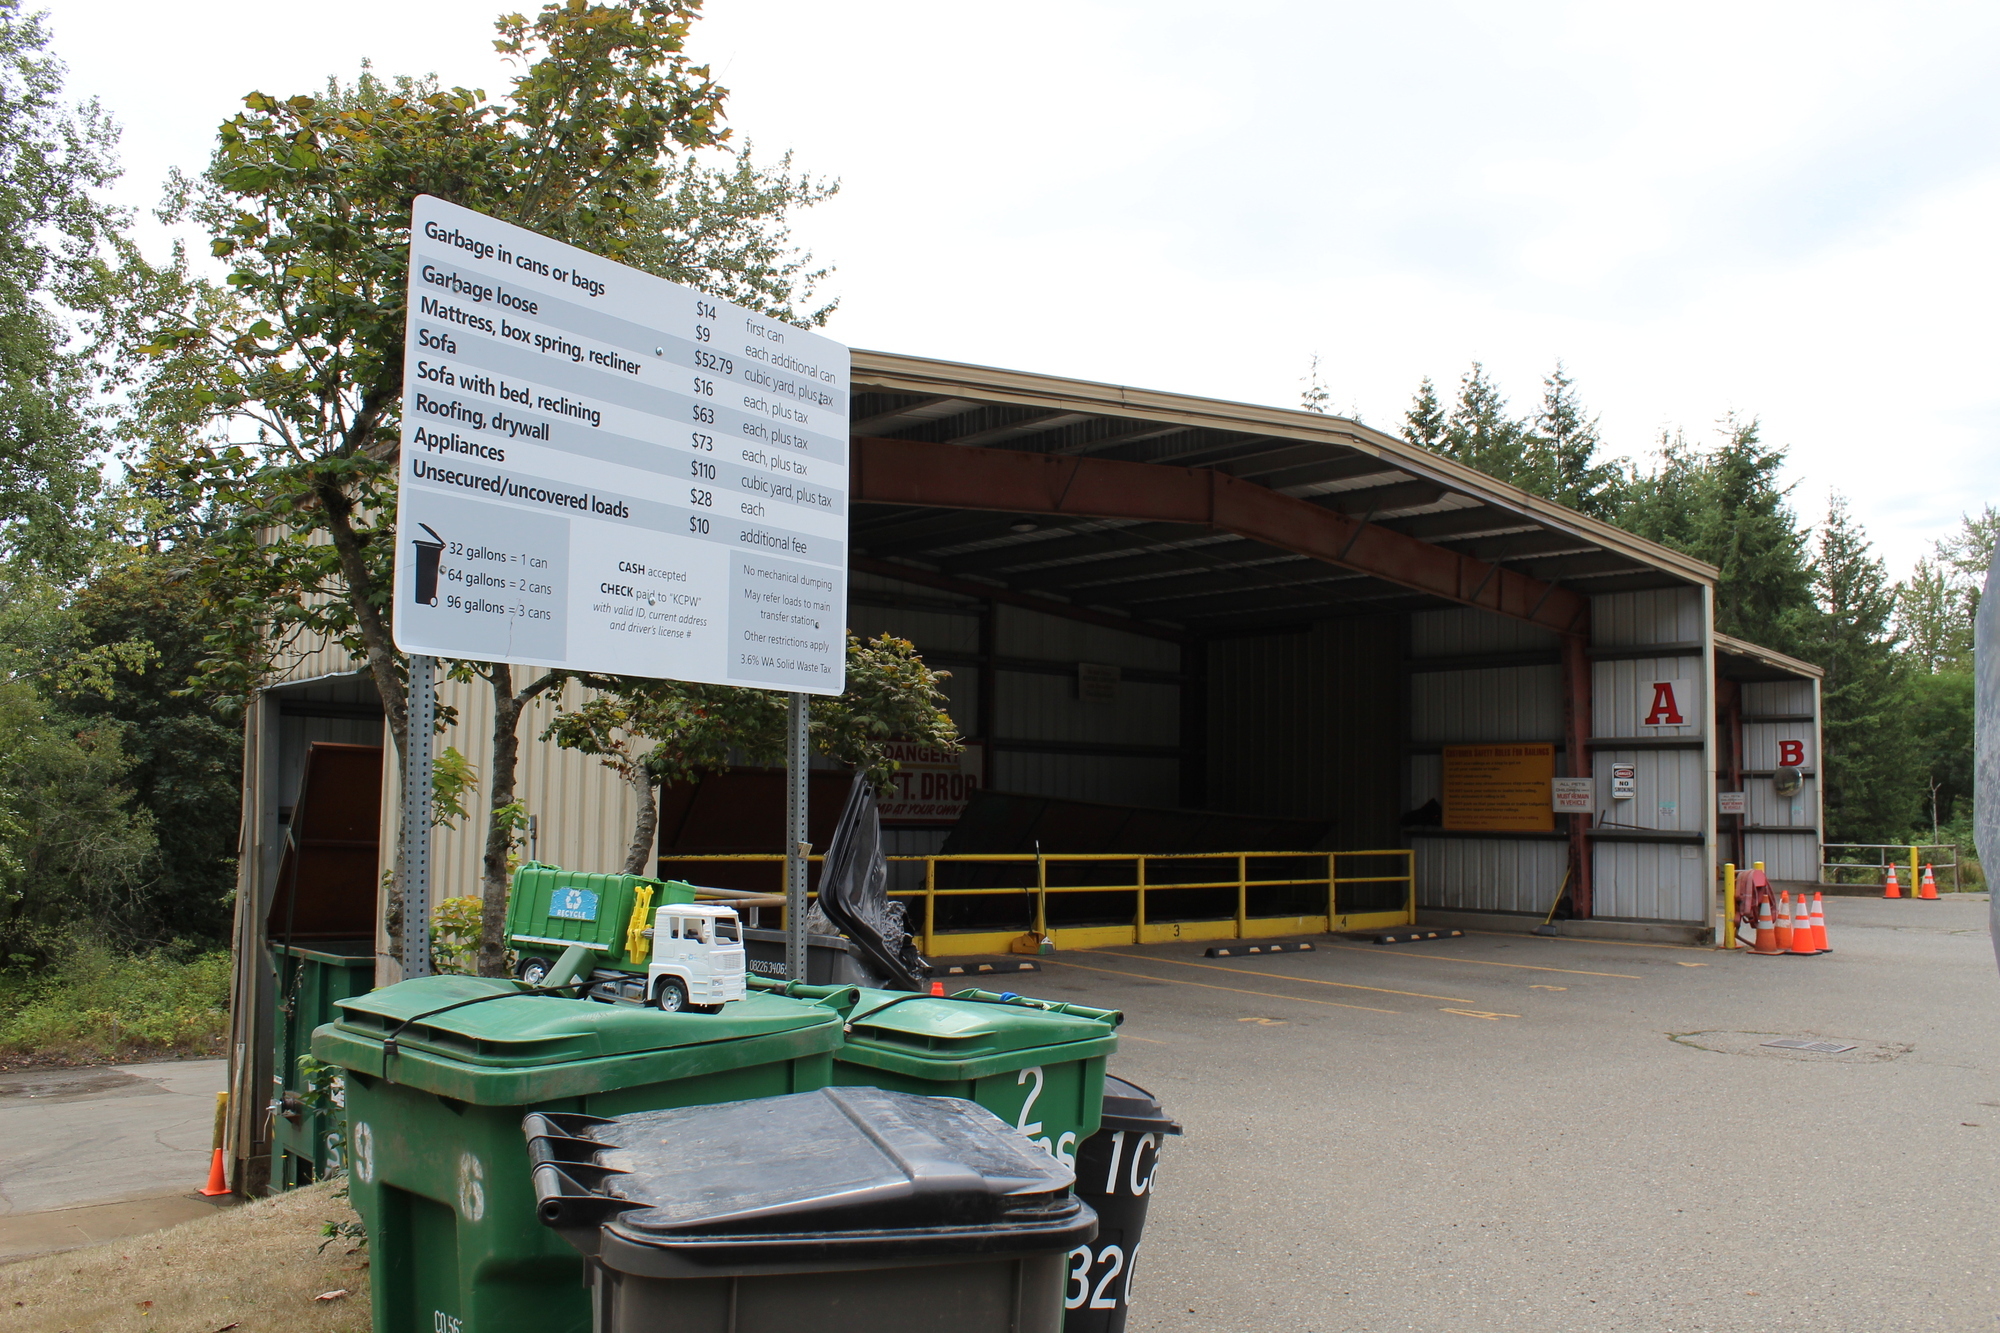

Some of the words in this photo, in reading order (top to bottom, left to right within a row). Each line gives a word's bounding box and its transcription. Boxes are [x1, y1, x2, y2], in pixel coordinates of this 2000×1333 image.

[424, 221, 494, 259] Garbage
[497, 243, 512, 264] in
[515, 255, 549, 276] cans
[552, 268, 569, 282] or
[571, 268, 605, 297] bags
[422, 264, 492, 302] Garbage
[496, 286, 538, 315] loose
[696, 300, 716, 321] $14
[418, 328, 456, 354] Sofa
[421, 295, 496, 336] Mattress,
[501, 318, 531, 344] box
[534, 334, 584, 362] spring,
[589, 350, 641, 375] recliner
[695, 323, 710, 343] $9
[746, 318, 765, 338] first
[766, 329, 784, 344] can
[694, 349, 733, 375] $52.79
[745, 345, 769, 362] each
[770, 353, 817, 378] additional
[819, 370, 835, 384] can
[417, 360, 454, 386] Sofa
[459, 374, 495, 396] with
[499, 380, 533, 409] bed,
[537, 396, 600, 427] reclining
[693, 376, 713, 397] $16
[744, 368, 771, 387] cubic
[772, 378, 796, 397] yard,
[798, 384, 817, 402] plus
[817, 391, 833, 407] tax
[416, 392, 487, 430] Roofing,
[491, 412, 549, 441] drywall
[692, 403, 714, 424] $63
[743, 396, 769, 415] each,
[771, 402, 792, 420] plus
[793, 409, 808, 424] tax
[413, 426, 505, 462] Appliances
[691, 431, 713, 452] $73
[742, 422, 768, 441] each,
[771, 428, 791, 445] plus
[793, 434, 808, 450] tax
[690, 459, 716, 480] $110
[741, 449, 768, 467] each,
[770, 454, 791, 472] plus
[792, 460, 807, 475] tax
[413, 458, 588, 510] Unsecured/uncovered
[591, 494, 628, 519] loads
[690, 487, 712, 507] $28
[741, 475, 768, 493] cubic
[769, 483, 793, 500] yard,
[796, 487, 816, 504] plus
[817, 492, 832, 507] tax
[740, 501, 765, 517] each
[689, 515, 710, 535] $10
[739, 528, 790, 550] additional
[791, 537, 807, 554] fee
[449, 541, 463, 556] 32
[466, 545, 506, 563] gallons
[521, 553, 526, 565] 1
[529, 557, 548, 569] can
[447, 568, 463, 582] 64
[465, 572, 506, 589] gallons
[519, 578, 526, 591] 2
[528, 583, 552, 595] cans
[618, 560, 645, 575] CASH
[647, 568, 687, 582] accepted
[743, 564, 755, 576] No
[757, 569, 798, 583] mechanical
[800, 574, 832, 592] dumping
[600, 582, 634, 598] CHECK
[657, 592, 667, 603] to
[744, 588, 761, 603] May
[762, 592, 781, 603] refer
[782, 594, 802, 607] loads
[803, 599, 812, 609] to
[813, 601, 830, 611] main
[446, 594, 461, 609] 96
[464, 598, 505, 615] gallons
[518, 604, 525, 617] 3
[527, 608, 551, 620] cans
[593, 601, 611, 613] with
[613, 604, 634, 616] valid
[635, 607, 646, 619] ID,
[648, 611, 677, 622] current
[678, 614, 707, 626] address
[760, 609, 789, 622] transfer
[609, 620, 626, 631] and
[657, 625, 684, 639] license
[686, 629, 692, 638] #
[743, 629, 766, 642] Other
[768, 635, 808, 648] restrictions
[809, 640, 829, 654] apply
[740, 653, 759, 666] 3.6%
[760, 656, 775, 667] WA
[776, 657, 795, 670] Solid
[796, 660, 818, 673] Waste
[820, 663, 831, 673] Tax
[1645, 682, 1684, 725] A
[1779, 740, 1805, 767] B
[893, 804, 907, 815] AT
[907, 804, 935, 816] YOUR
[935, 804, 960, 816] OWN
[556, 909, 587, 919] RECYCLE
[1341, 916, 1347, 928] 4
[1173, 924, 1180, 937] 3
[1017, 1066, 1044, 1136] 2
[1105, 1131, 1125, 1194] 1
[1130, 1132, 1161, 1196] Ca
[1065, 1244, 1124, 1310] 32
